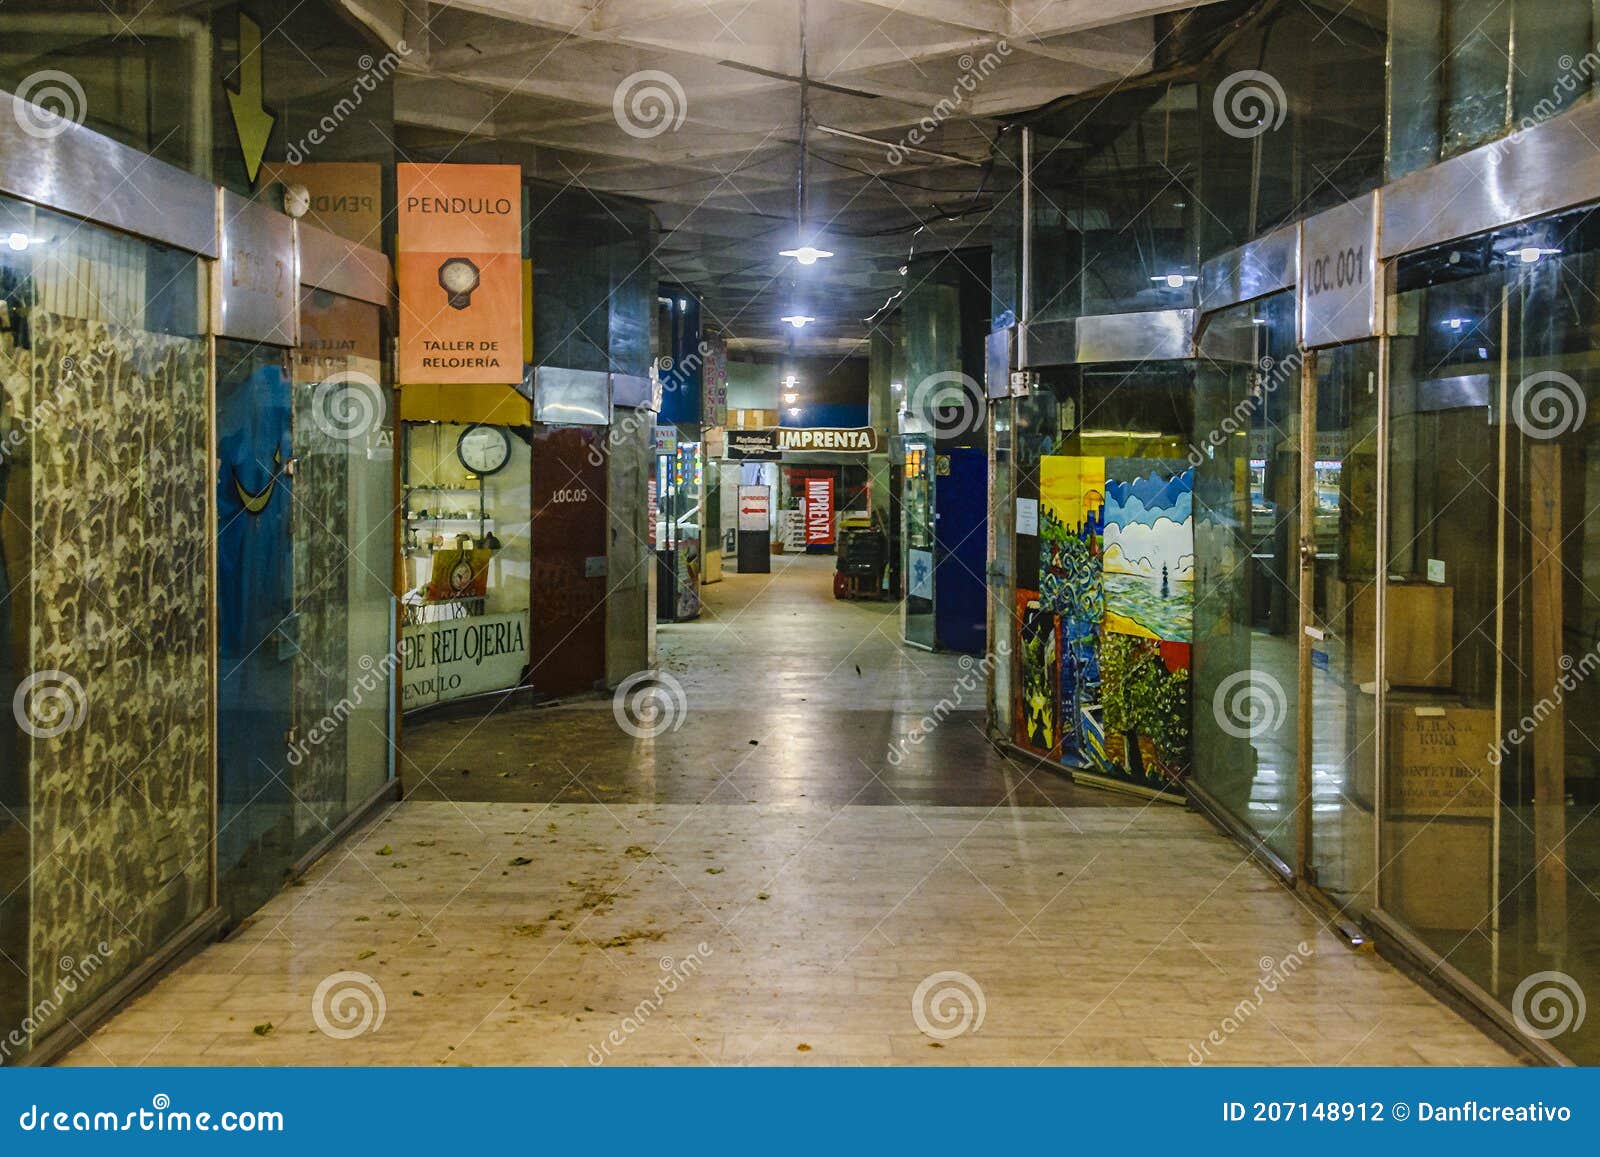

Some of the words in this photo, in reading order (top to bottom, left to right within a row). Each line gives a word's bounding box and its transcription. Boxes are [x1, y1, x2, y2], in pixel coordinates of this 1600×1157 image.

[407, 196, 511, 215] PENDULO
[423, 340, 475, 351] TALLER
[479, 340, 499, 351] DE
[422, 356, 500, 368] RELOJERÍA
[778, 431, 872, 449] IMPRENTA
[809, 481, 830, 540] IMPRENTA
[405, 634, 425, 671] DE
[432, 620, 524, 666] RELOJERIA
[402, 674, 461, 701] ENDULO
